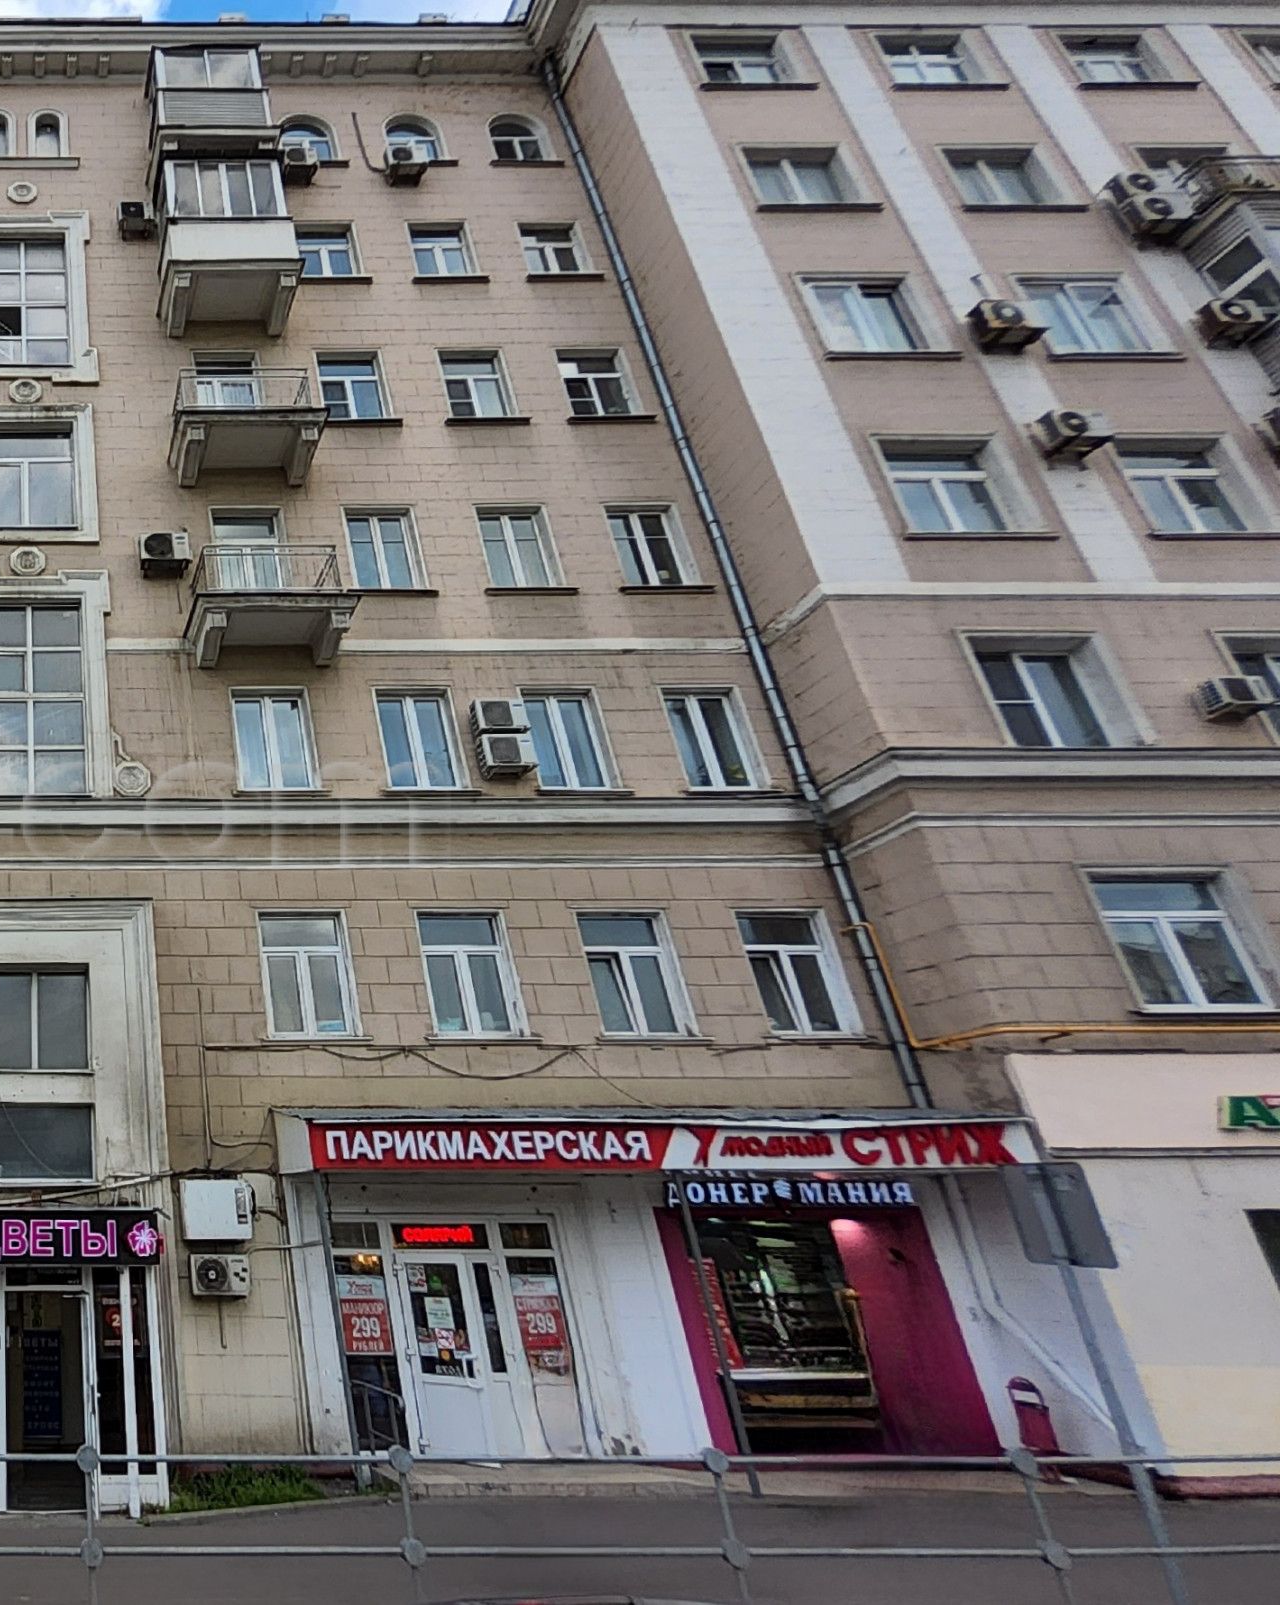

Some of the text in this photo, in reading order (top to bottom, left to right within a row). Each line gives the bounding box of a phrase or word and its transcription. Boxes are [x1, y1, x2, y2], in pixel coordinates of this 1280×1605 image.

[325, 1129, 652, 1162] ПАРИКМАХЕРСКАЯ
[840, 1125, 1018, 1167] СТРИЖ
[667, 1182, 914, 1207] ДОНЕР МАНИЯ
[351, 1316, 381, 1339] 299
[526, 1312, 557, 1334] 299
